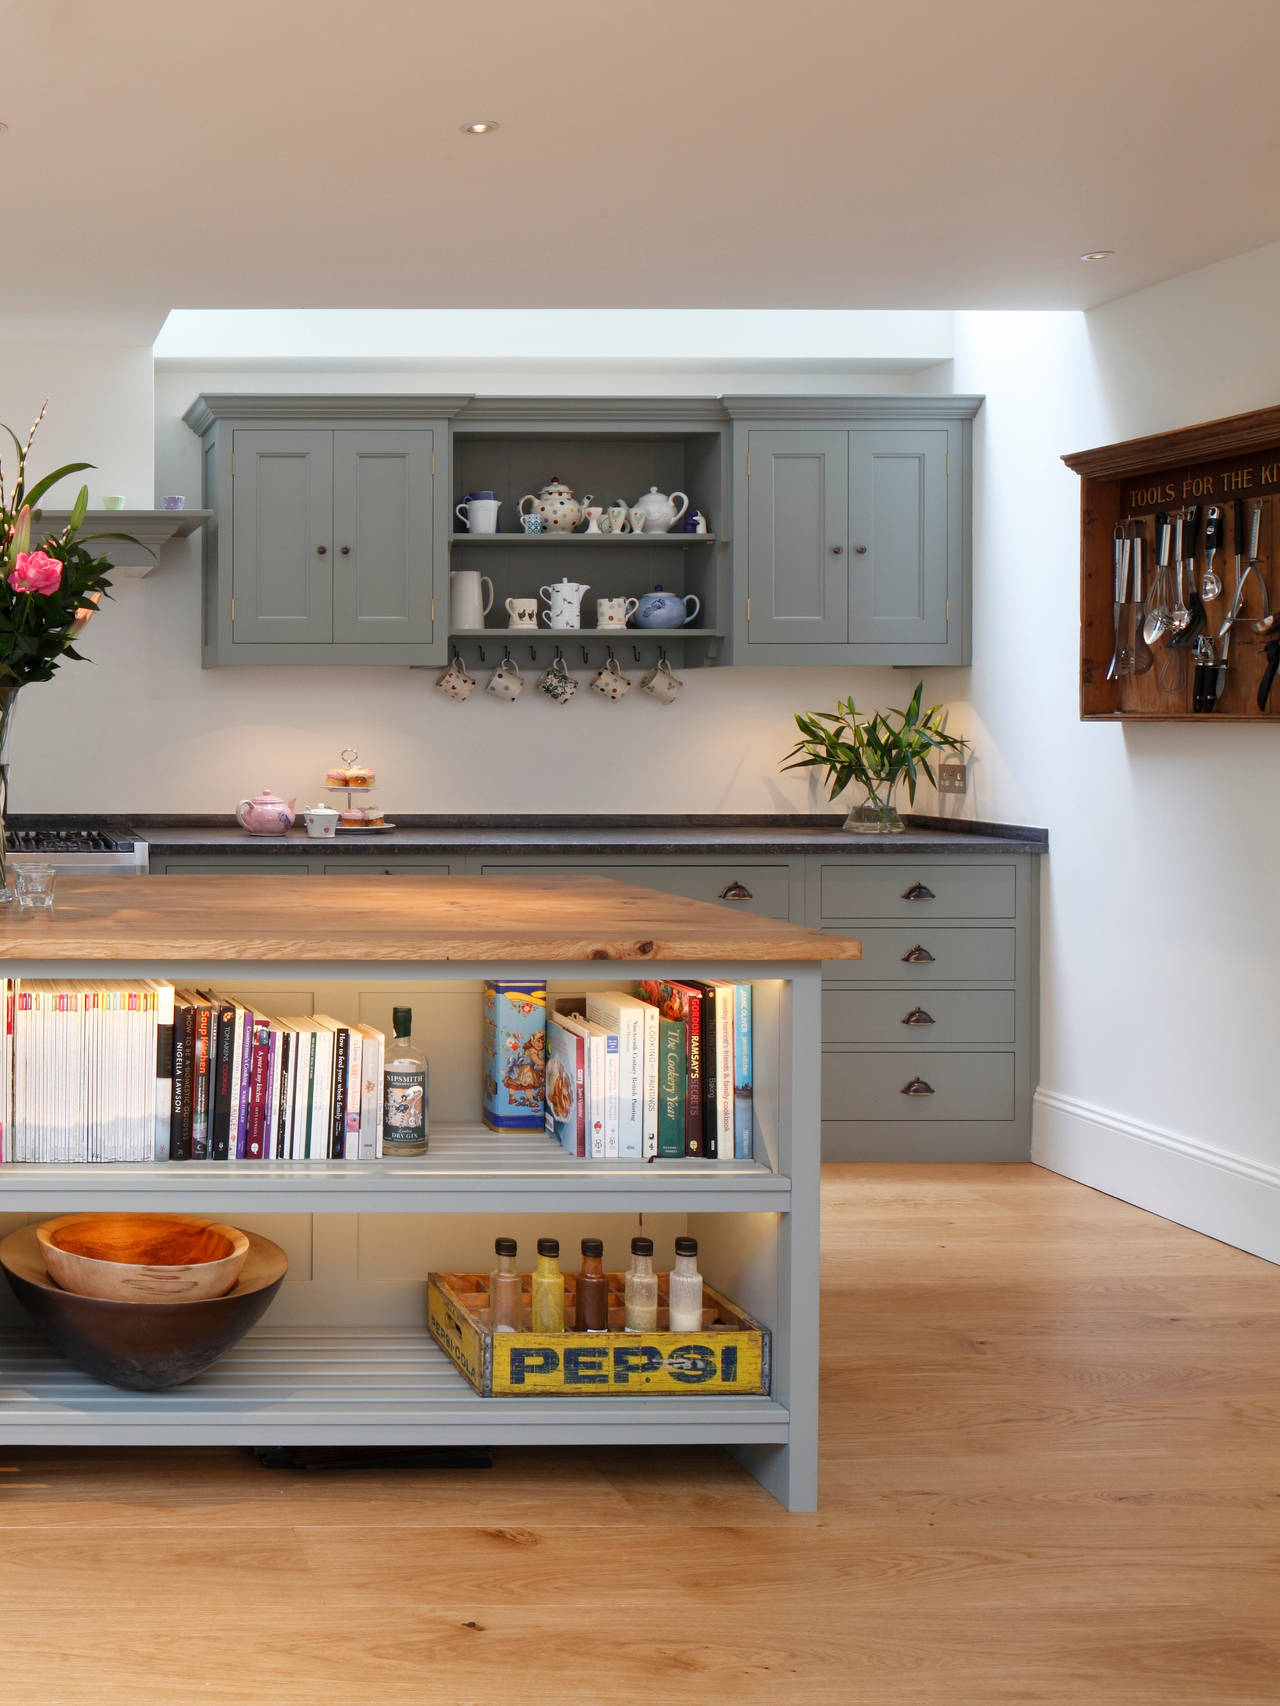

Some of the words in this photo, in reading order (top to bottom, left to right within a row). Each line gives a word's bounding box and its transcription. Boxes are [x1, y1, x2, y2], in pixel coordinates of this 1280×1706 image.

[1130, 484, 1176, 508] TOOLS
[1183, 476, 1214, 498] FOR
[1221, 469, 1253, 491] THE
[198, 1011, 209, 1035] Soup
[691, 999, 699, 1035] GORDON
[185, 1036, 191, 1046] TO
[243, 1026, 251, 1062] Countryman's
[338, 1033, 346, 1046] How
[667, 1030, 680, 1048] The
[175, 1042, 183, 1075] NIGELLA
[199, 1037, 209, 1074] Kitchen
[691, 1035, 699, 1079] RAMSAY'S
[241, 1063, 249, 1086] Cooking
[255, 1073, 262, 1083] my
[336, 1069, 344, 1083] your
[663, 1051, 679, 1093] Cookery
[255, 1084, 263, 1103] kitchen
[336, 1084, 344, 1101] whole
[690, 1079, 699, 1115] SECRETS
[722, 1080, 730, 1099] family
[335, 1102, 343, 1121] family
[630, 1098, 638, 1122] Painting
[666, 1096, 678, 1120] Year
[509, 1345, 738, 1385] PEPSI
